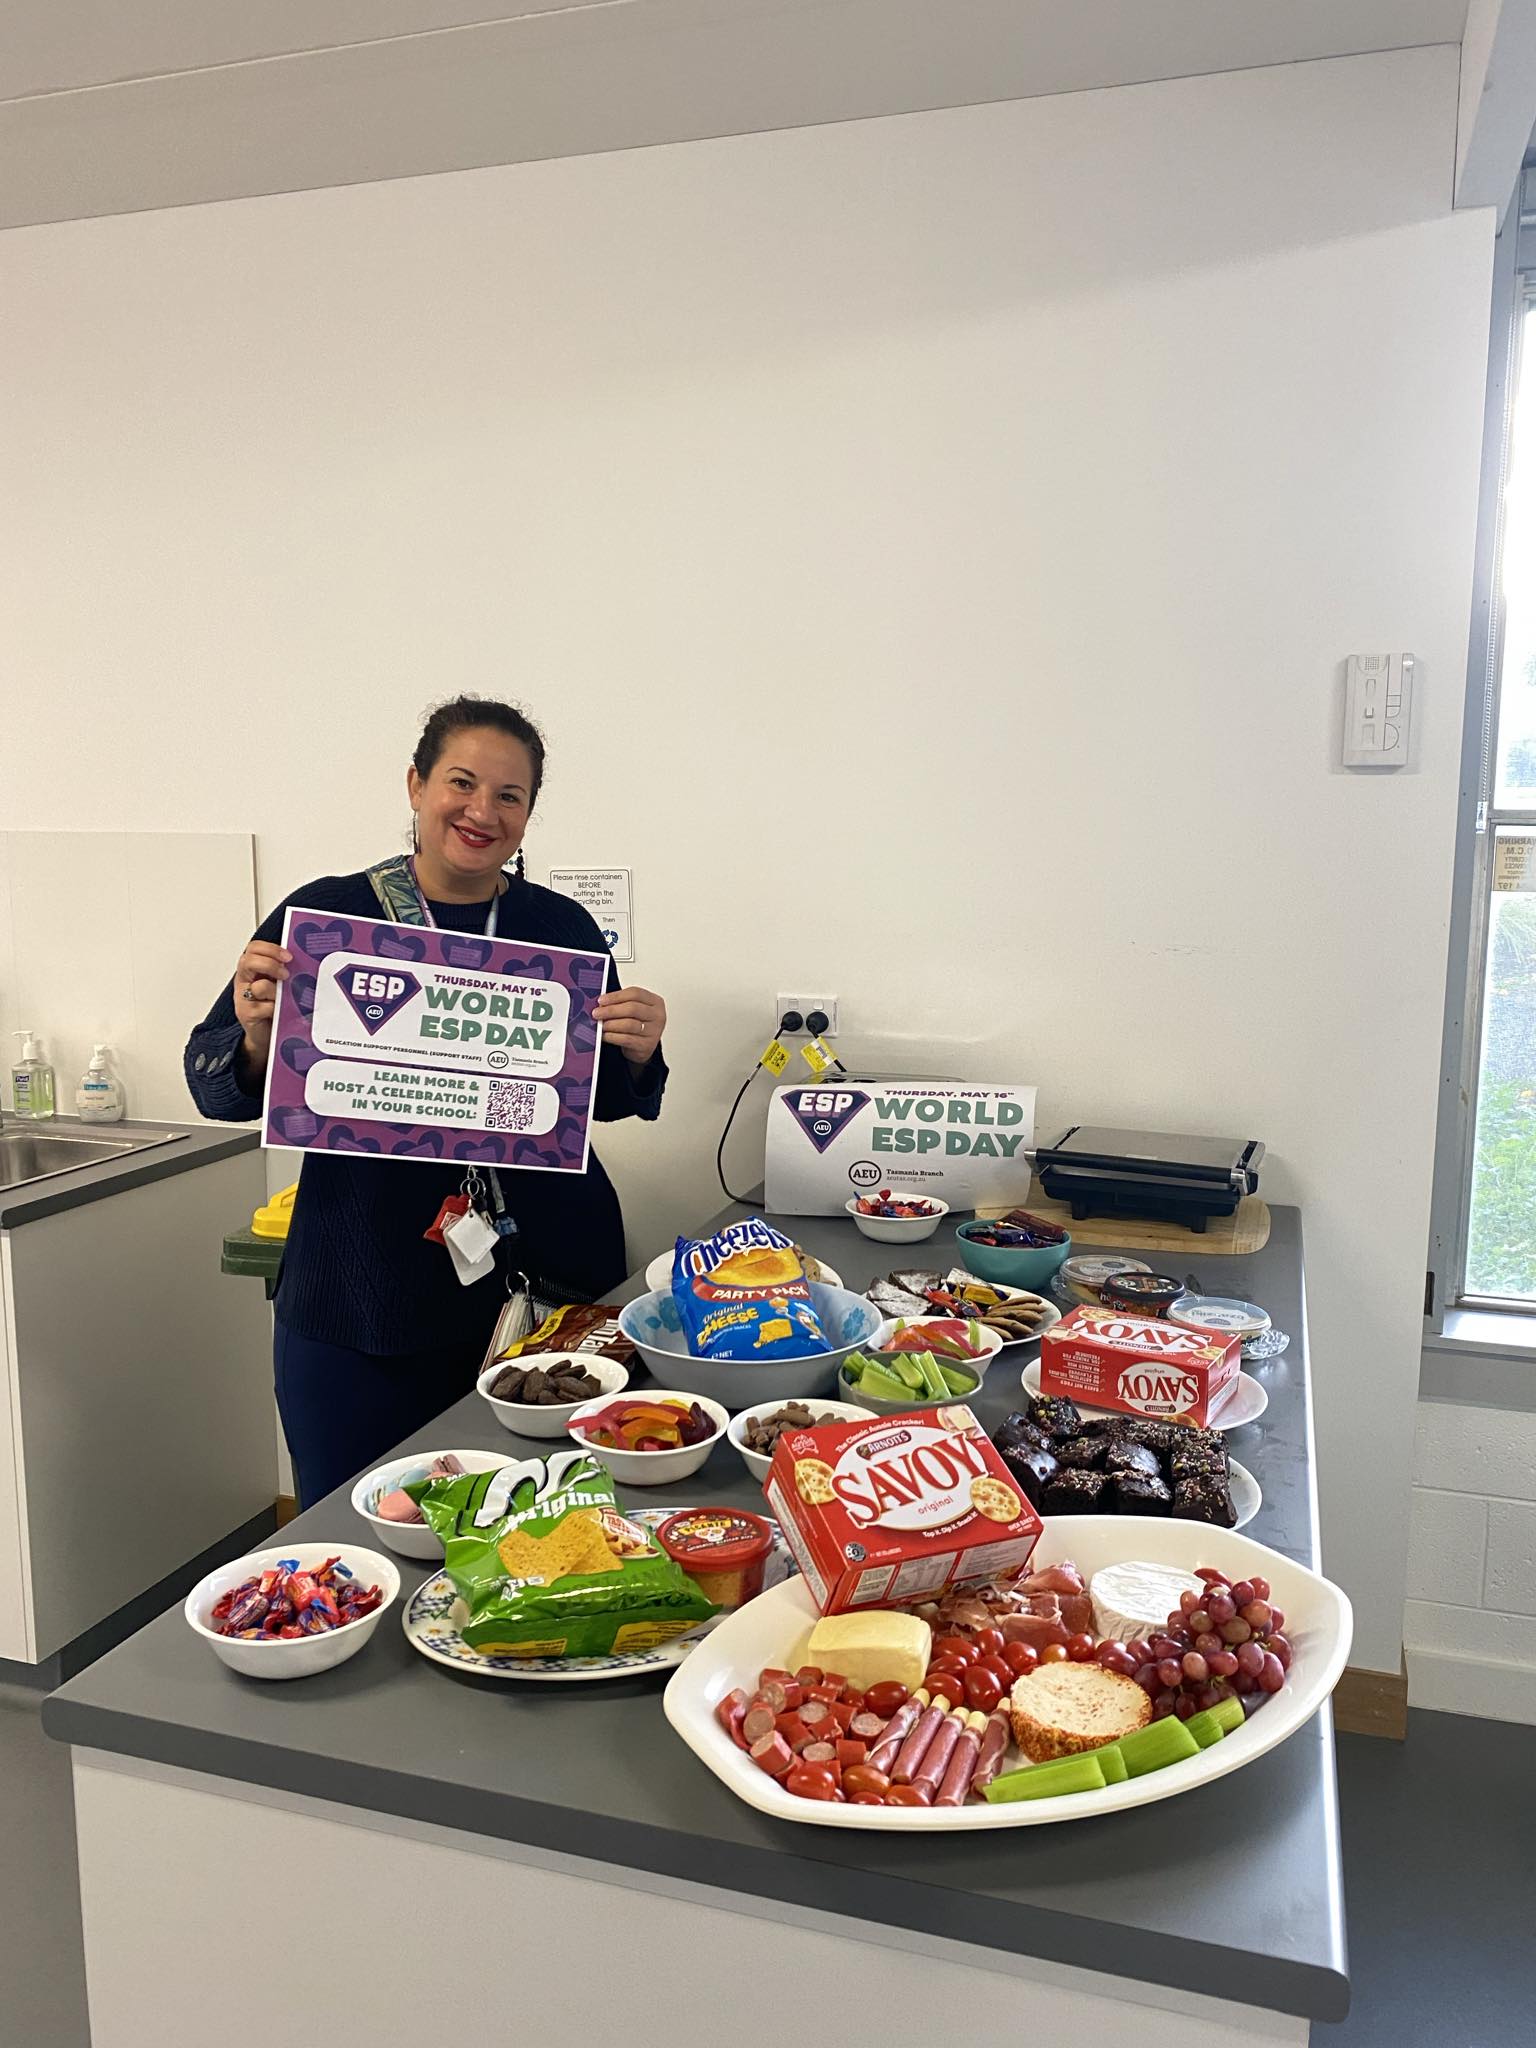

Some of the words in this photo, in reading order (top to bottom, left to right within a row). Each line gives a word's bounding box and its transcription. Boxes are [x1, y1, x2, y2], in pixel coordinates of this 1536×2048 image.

[573, 890, 596, 898] putting
[351, 971, 406, 1001] ESP
[434, 974, 499, 992] THURSDAY,
[502, 984, 528, 995] MAY
[424, 985, 554, 1022] WORLD
[420, 1014, 482, 1042] ESP
[485, 1022, 552, 1050] DAY
[326, 1039, 362, 1048] EDUCATION
[393, 1046, 428, 1056] PERSONNEL
[462, 1054, 482, 1062] STAFF)
[490, 1056, 506, 1064] AEU
[374, 1071, 420, 1084] LEARN
[424, 1077, 466, 1090] MORE
[469, 1081, 480, 1091] &
[324, 1081, 364, 1094] HOST
[367, 1086, 378, 1096] A
[382, 1087, 478, 1105] CELEBRATION
[798, 1092, 854, 1114] ESP
[884, 1090, 958, 1098] THURSDAY,
[352, 1098, 368, 1109] IN
[372, 1100, 412, 1114] YOUR
[416, 1106, 477, 1119] SCHOOL:
[874, 1098, 1024, 1126] WORLD
[872, 1126, 941, 1154] ESP
[946, 1131, 1024, 1158] DAY
[852, 1169, 878, 1178] AEU
[886, 1168, 918, 1176] Tasmania
[682, 1219, 794, 1278] Cheezels
[712, 1288, 768, 1299] PARTY
[771, 1286, 809, 1296] PACK
[703, 1302, 744, 1324] Original
[696, 1308, 760, 1345] CHEESE
[1077, 1319, 1214, 1350] SAVOY
[720, 1350, 733, 1358] NET
[1119, 1374, 1198, 1404] SAVOY
[832, 1434, 987, 1526] SAVOY
[918, 1496, 954, 1515] original
